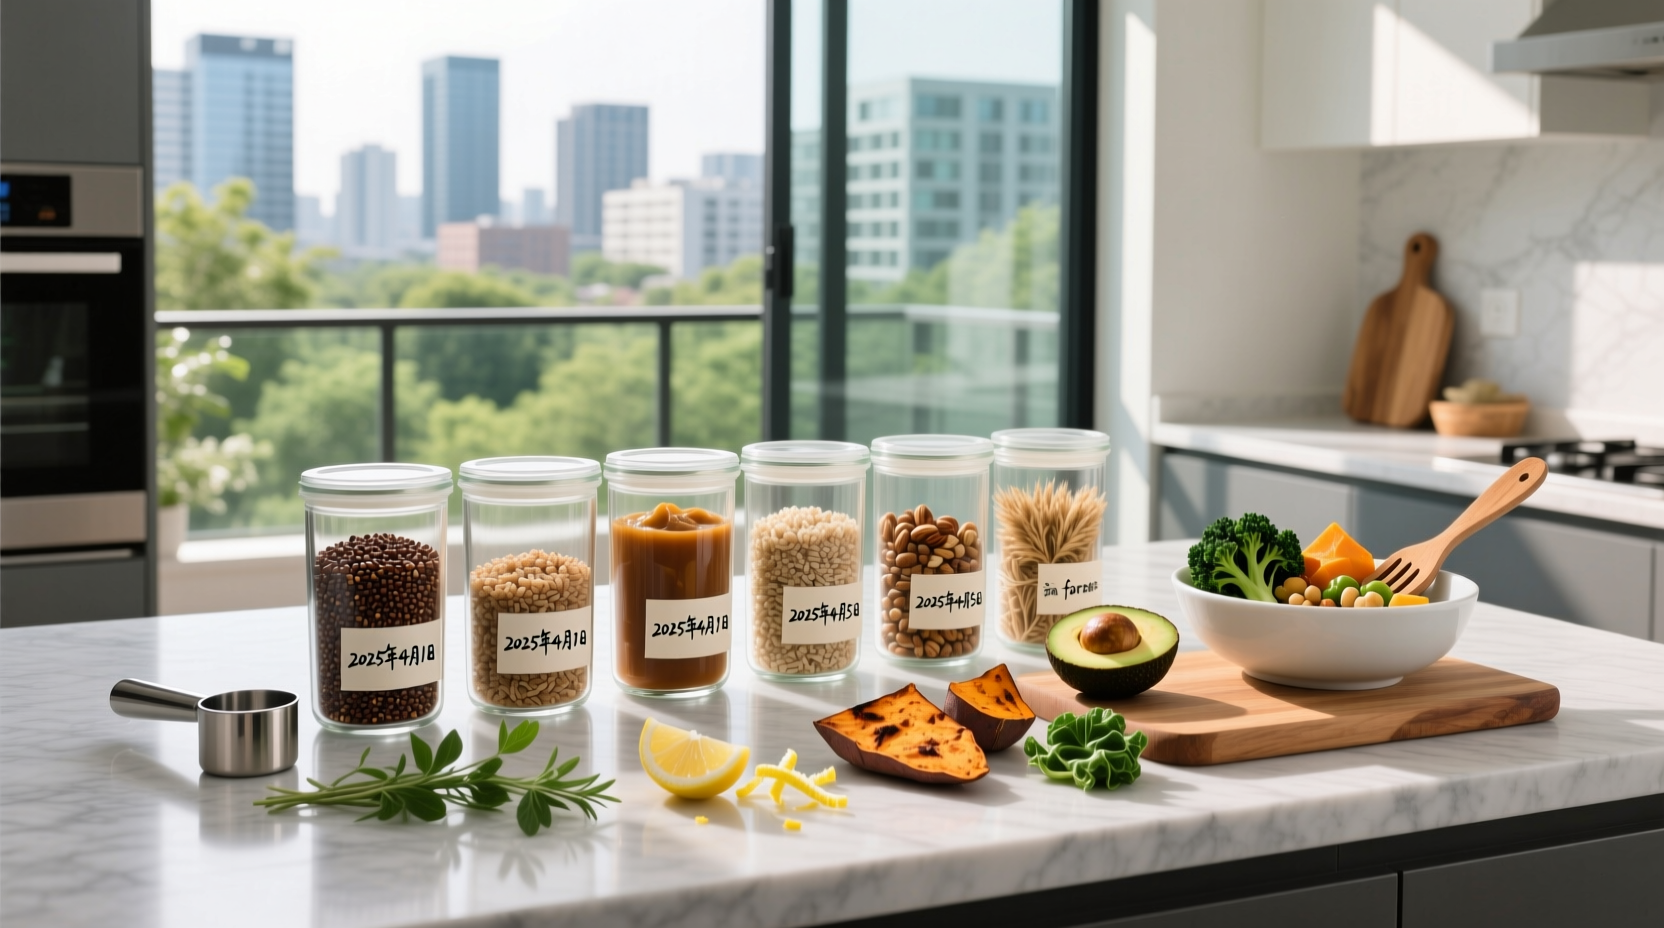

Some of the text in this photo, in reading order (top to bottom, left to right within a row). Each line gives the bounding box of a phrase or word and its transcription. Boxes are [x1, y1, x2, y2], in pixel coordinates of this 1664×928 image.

[651, 614, 729, 641] 2025年4月1日
[788, 601, 860, 627] 2025年4月5日
[503, 628, 587, 656] 2025年4月1日
[347, 643, 435, 671] 2025年4月1日
